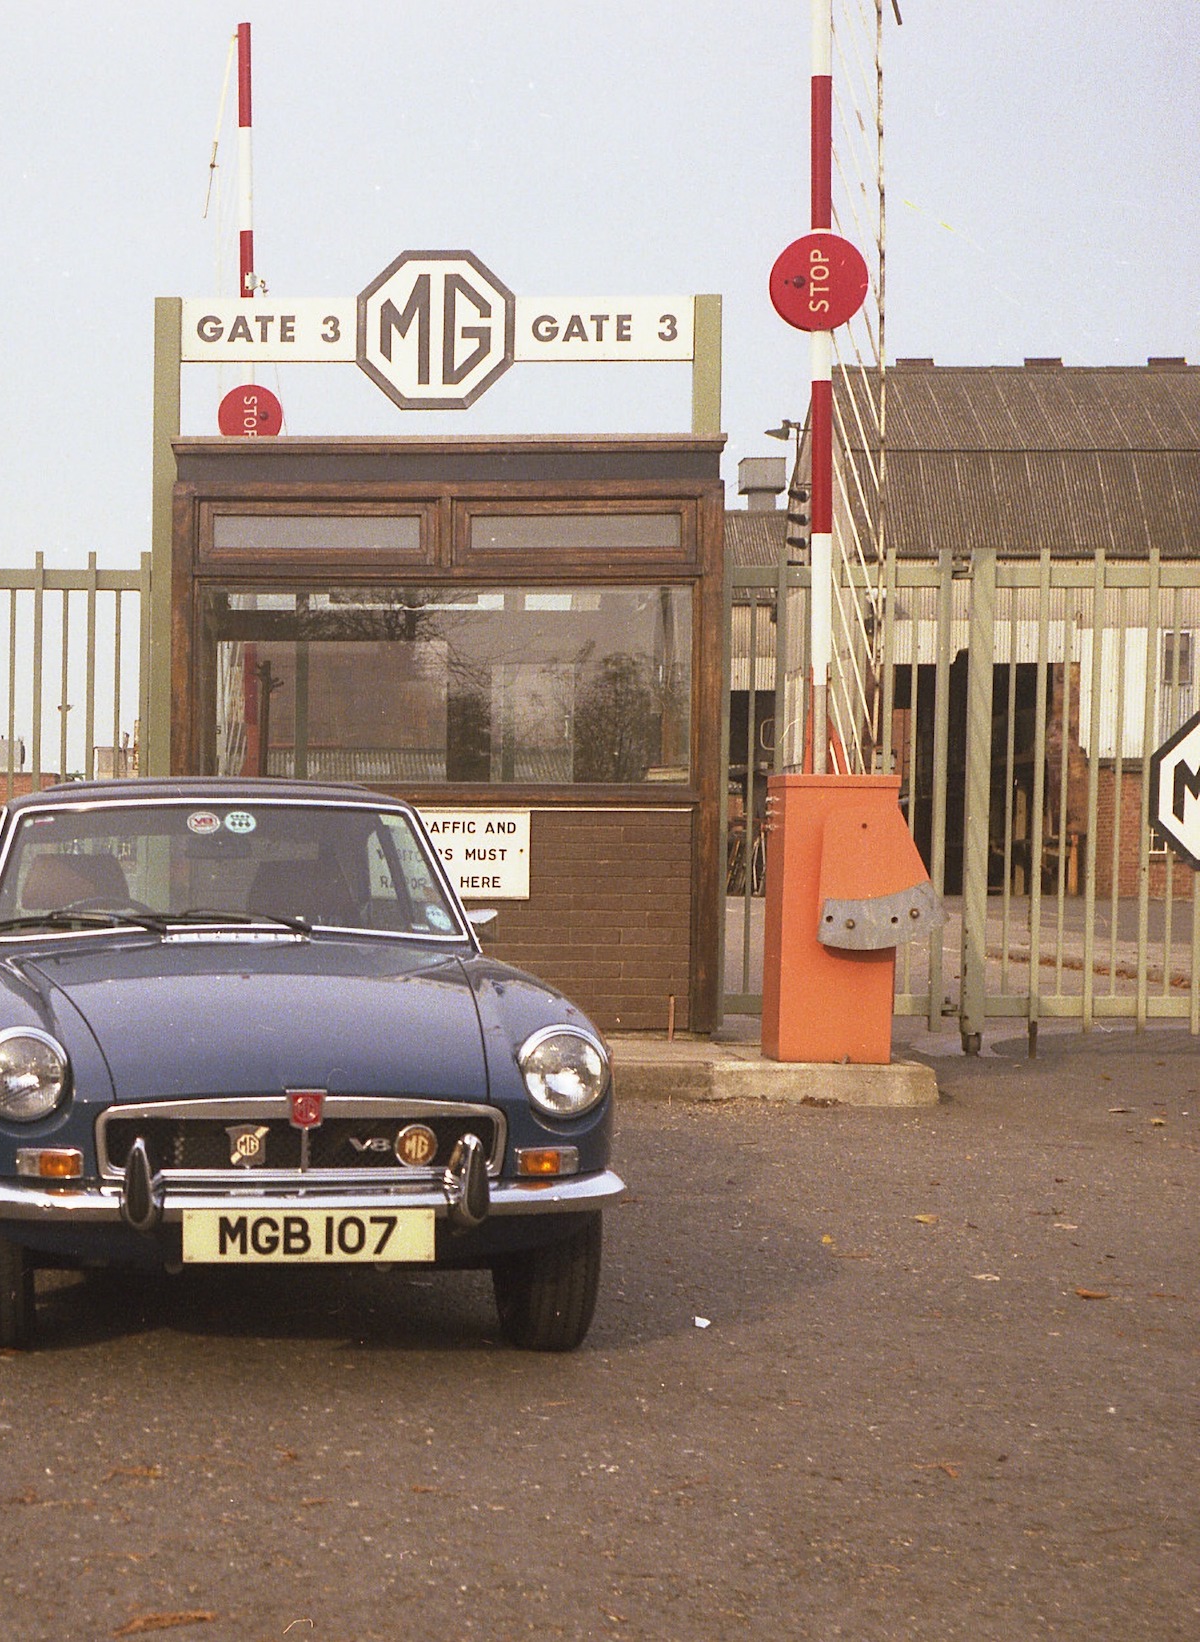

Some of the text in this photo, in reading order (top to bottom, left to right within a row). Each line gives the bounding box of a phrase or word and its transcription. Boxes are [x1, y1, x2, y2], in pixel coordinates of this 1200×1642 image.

[808, 249, 830, 313] STOP
[196, 315, 341, 344] GATE 3
[380, 274, 492, 385] MG
[531, 314, 679, 343] GATE 3
[425, 821, 517, 834] AFFIC AND
[465, 848, 508, 861] MUST
[460, 876, 502, 888] HERE
[349, 1138, 393, 1152] V8
[405, 1135, 429, 1159] MG
[218, 1216, 399, 1255] MGB 107
